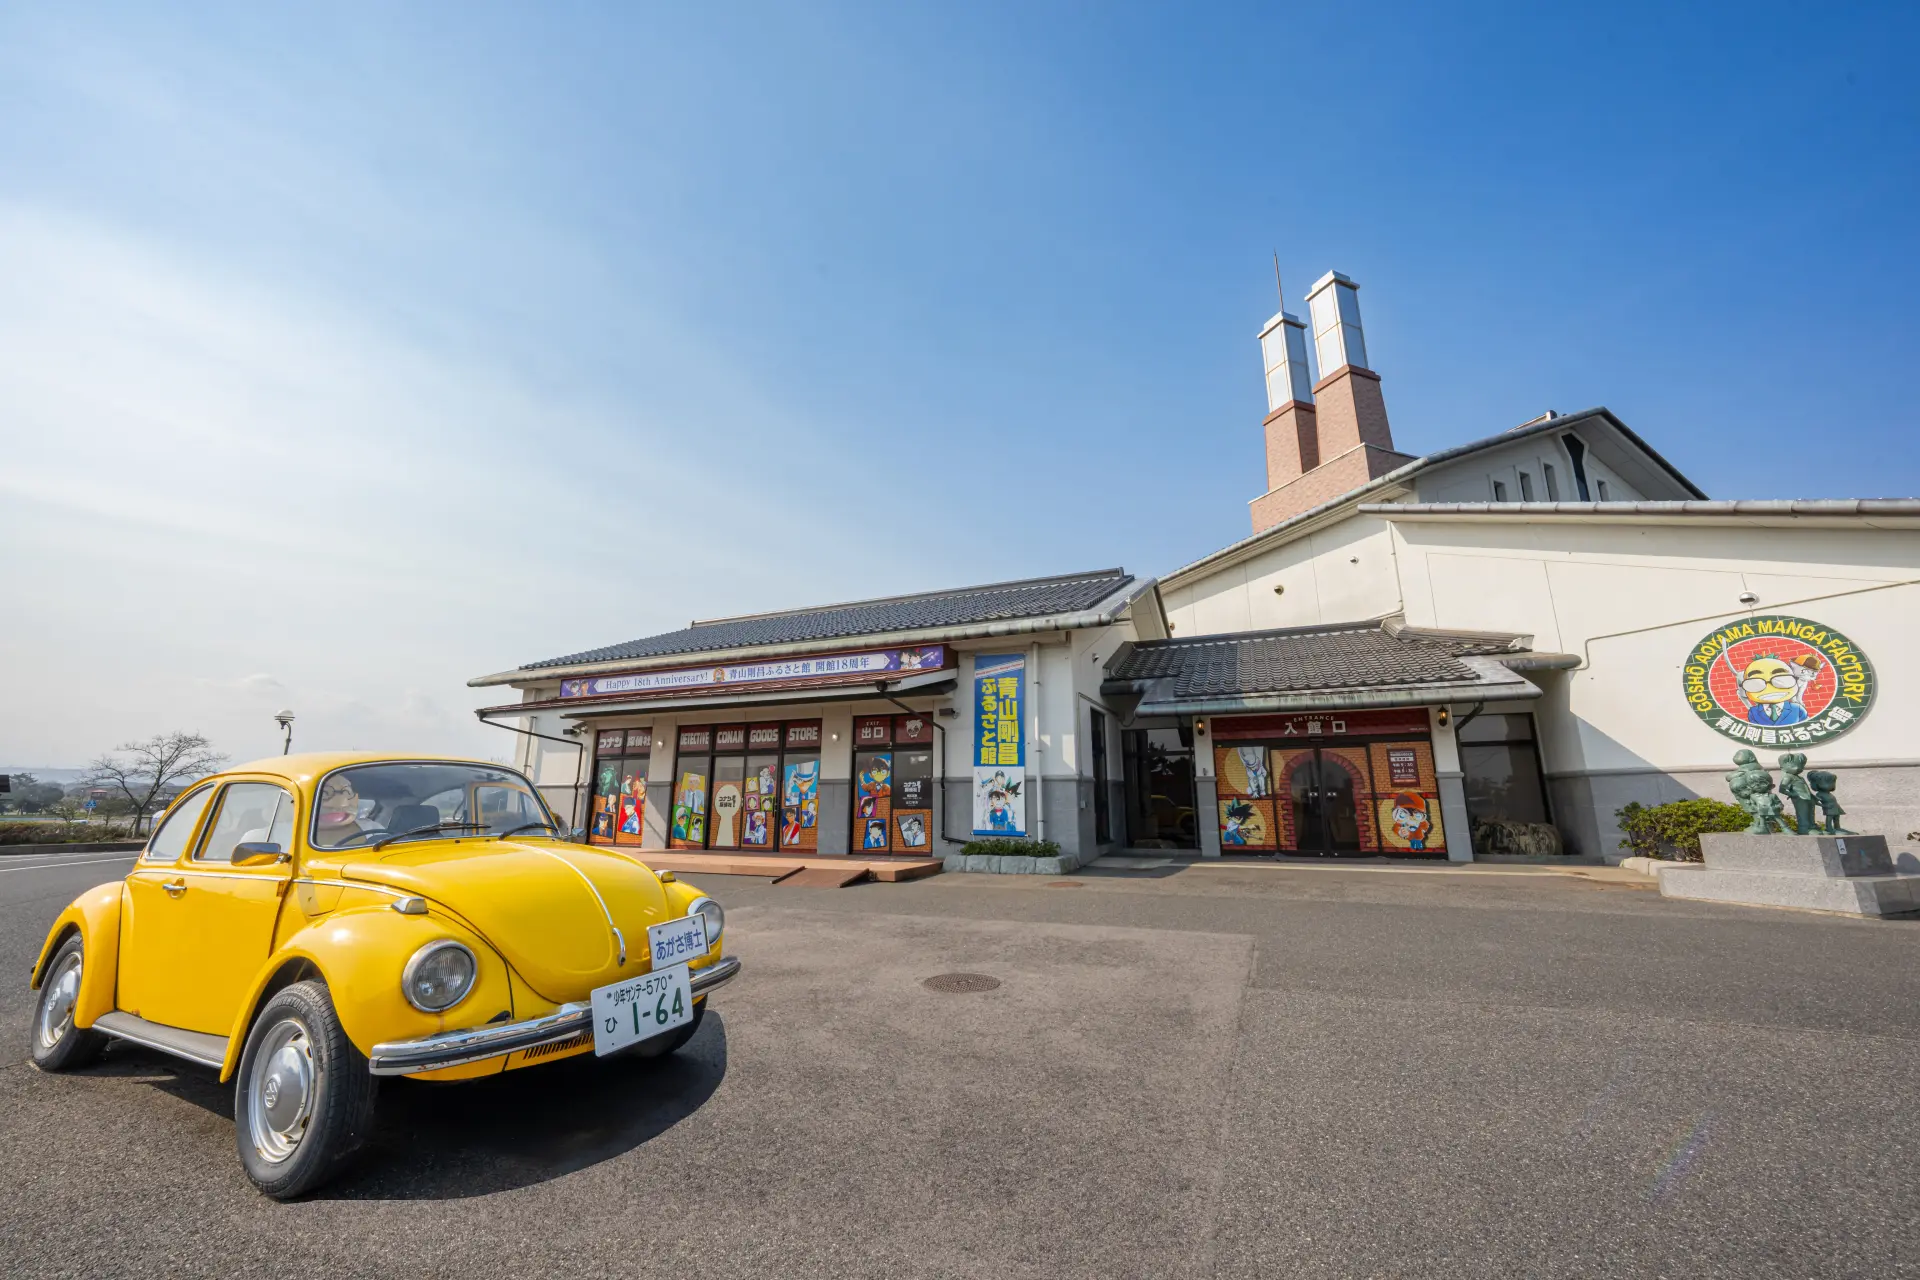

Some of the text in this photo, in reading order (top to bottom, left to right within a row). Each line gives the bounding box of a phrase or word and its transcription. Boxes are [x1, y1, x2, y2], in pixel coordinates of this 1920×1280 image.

[729, 656, 870, 680] 青山剛昌ふるさと館 開館18周年
[1694, 623, 1755, 665] AOYAMA
[1757, 619, 1827, 645] MANGA
[1822, 638, 1865, 703] FACTORY
[606, 671, 708, 690] Happy 18th Anniversary!
[861, 726, 884, 739] 出口
[980, 678, 997, 765] ふるさと館
[997, 677, 1019, 765] 青山剛昌
[1284, 720, 1347, 735] 入館口
[1714, 705, 1854, 744] 青山剛昌ふるさと館
[598, 736, 623, 748] コナン
[680, 726, 818, 745] DETECTIVE CONAN GOODS STORE
[656, 929, 702, 960] あがさ博士
[604, 987, 684, 1035] ひ 1-64
